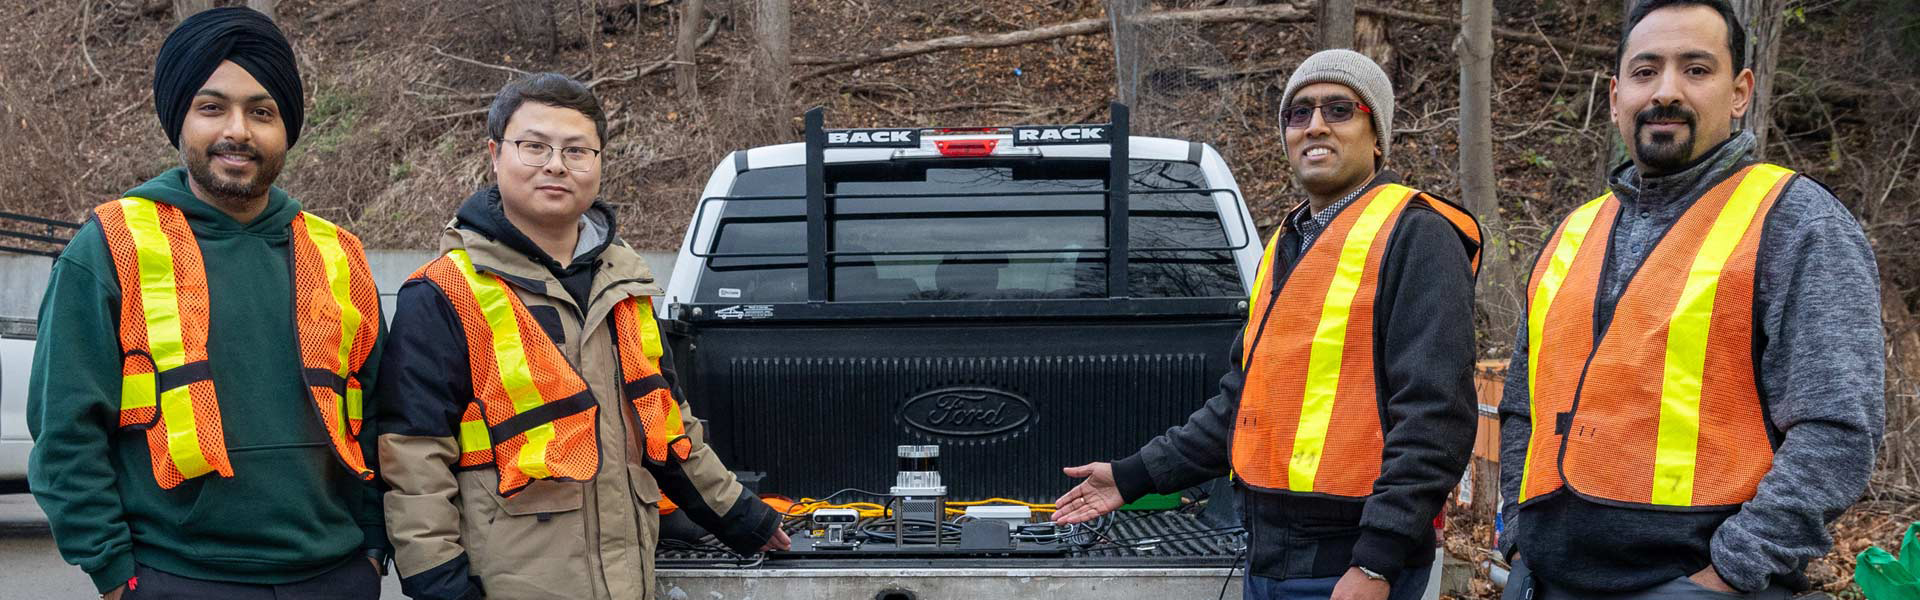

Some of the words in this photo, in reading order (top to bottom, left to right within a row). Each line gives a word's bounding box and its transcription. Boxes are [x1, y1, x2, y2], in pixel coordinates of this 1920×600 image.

[828, 131, 912, 144] BACK
[1019, 128, 1102, 141] RACK
[928, 393, 1006, 425] Ford
